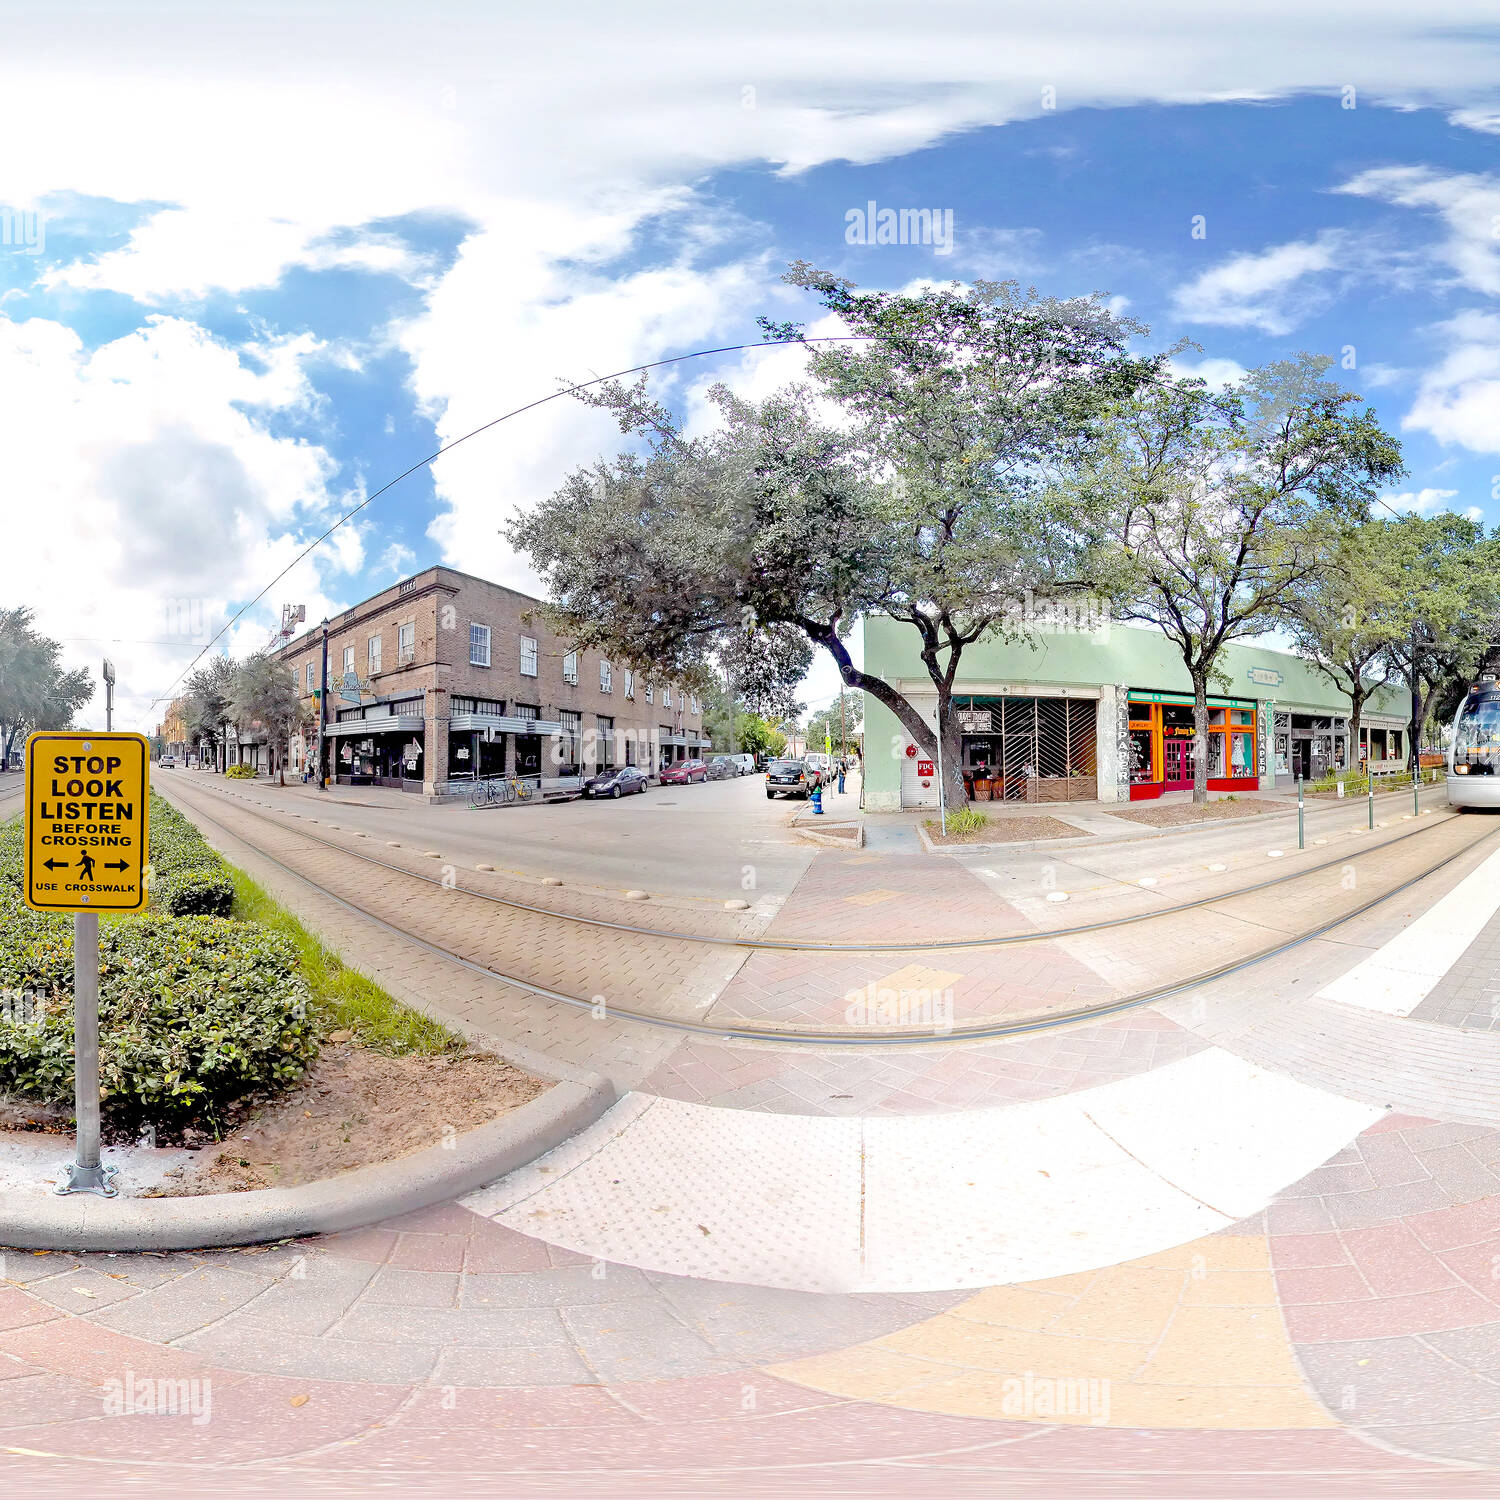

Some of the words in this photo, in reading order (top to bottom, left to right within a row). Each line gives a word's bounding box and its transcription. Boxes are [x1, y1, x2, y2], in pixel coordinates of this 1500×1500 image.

[1265, 701, 1273, 736] SHOP
[1117, 691, 1128, 780] WALLPAPER
[1258, 702, 1267, 773] WALLPAPER
[53, 756, 122, 774] STOP
[51, 779, 124, 797] LOOK
[41, 802, 133, 820] LISTEN
[52, 824, 121, 834] BEFORE
[41, 836, 132, 846] CROSSING
[35, 883, 58, 891] USE
[65, 883, 135, 893] CROSSWALK
